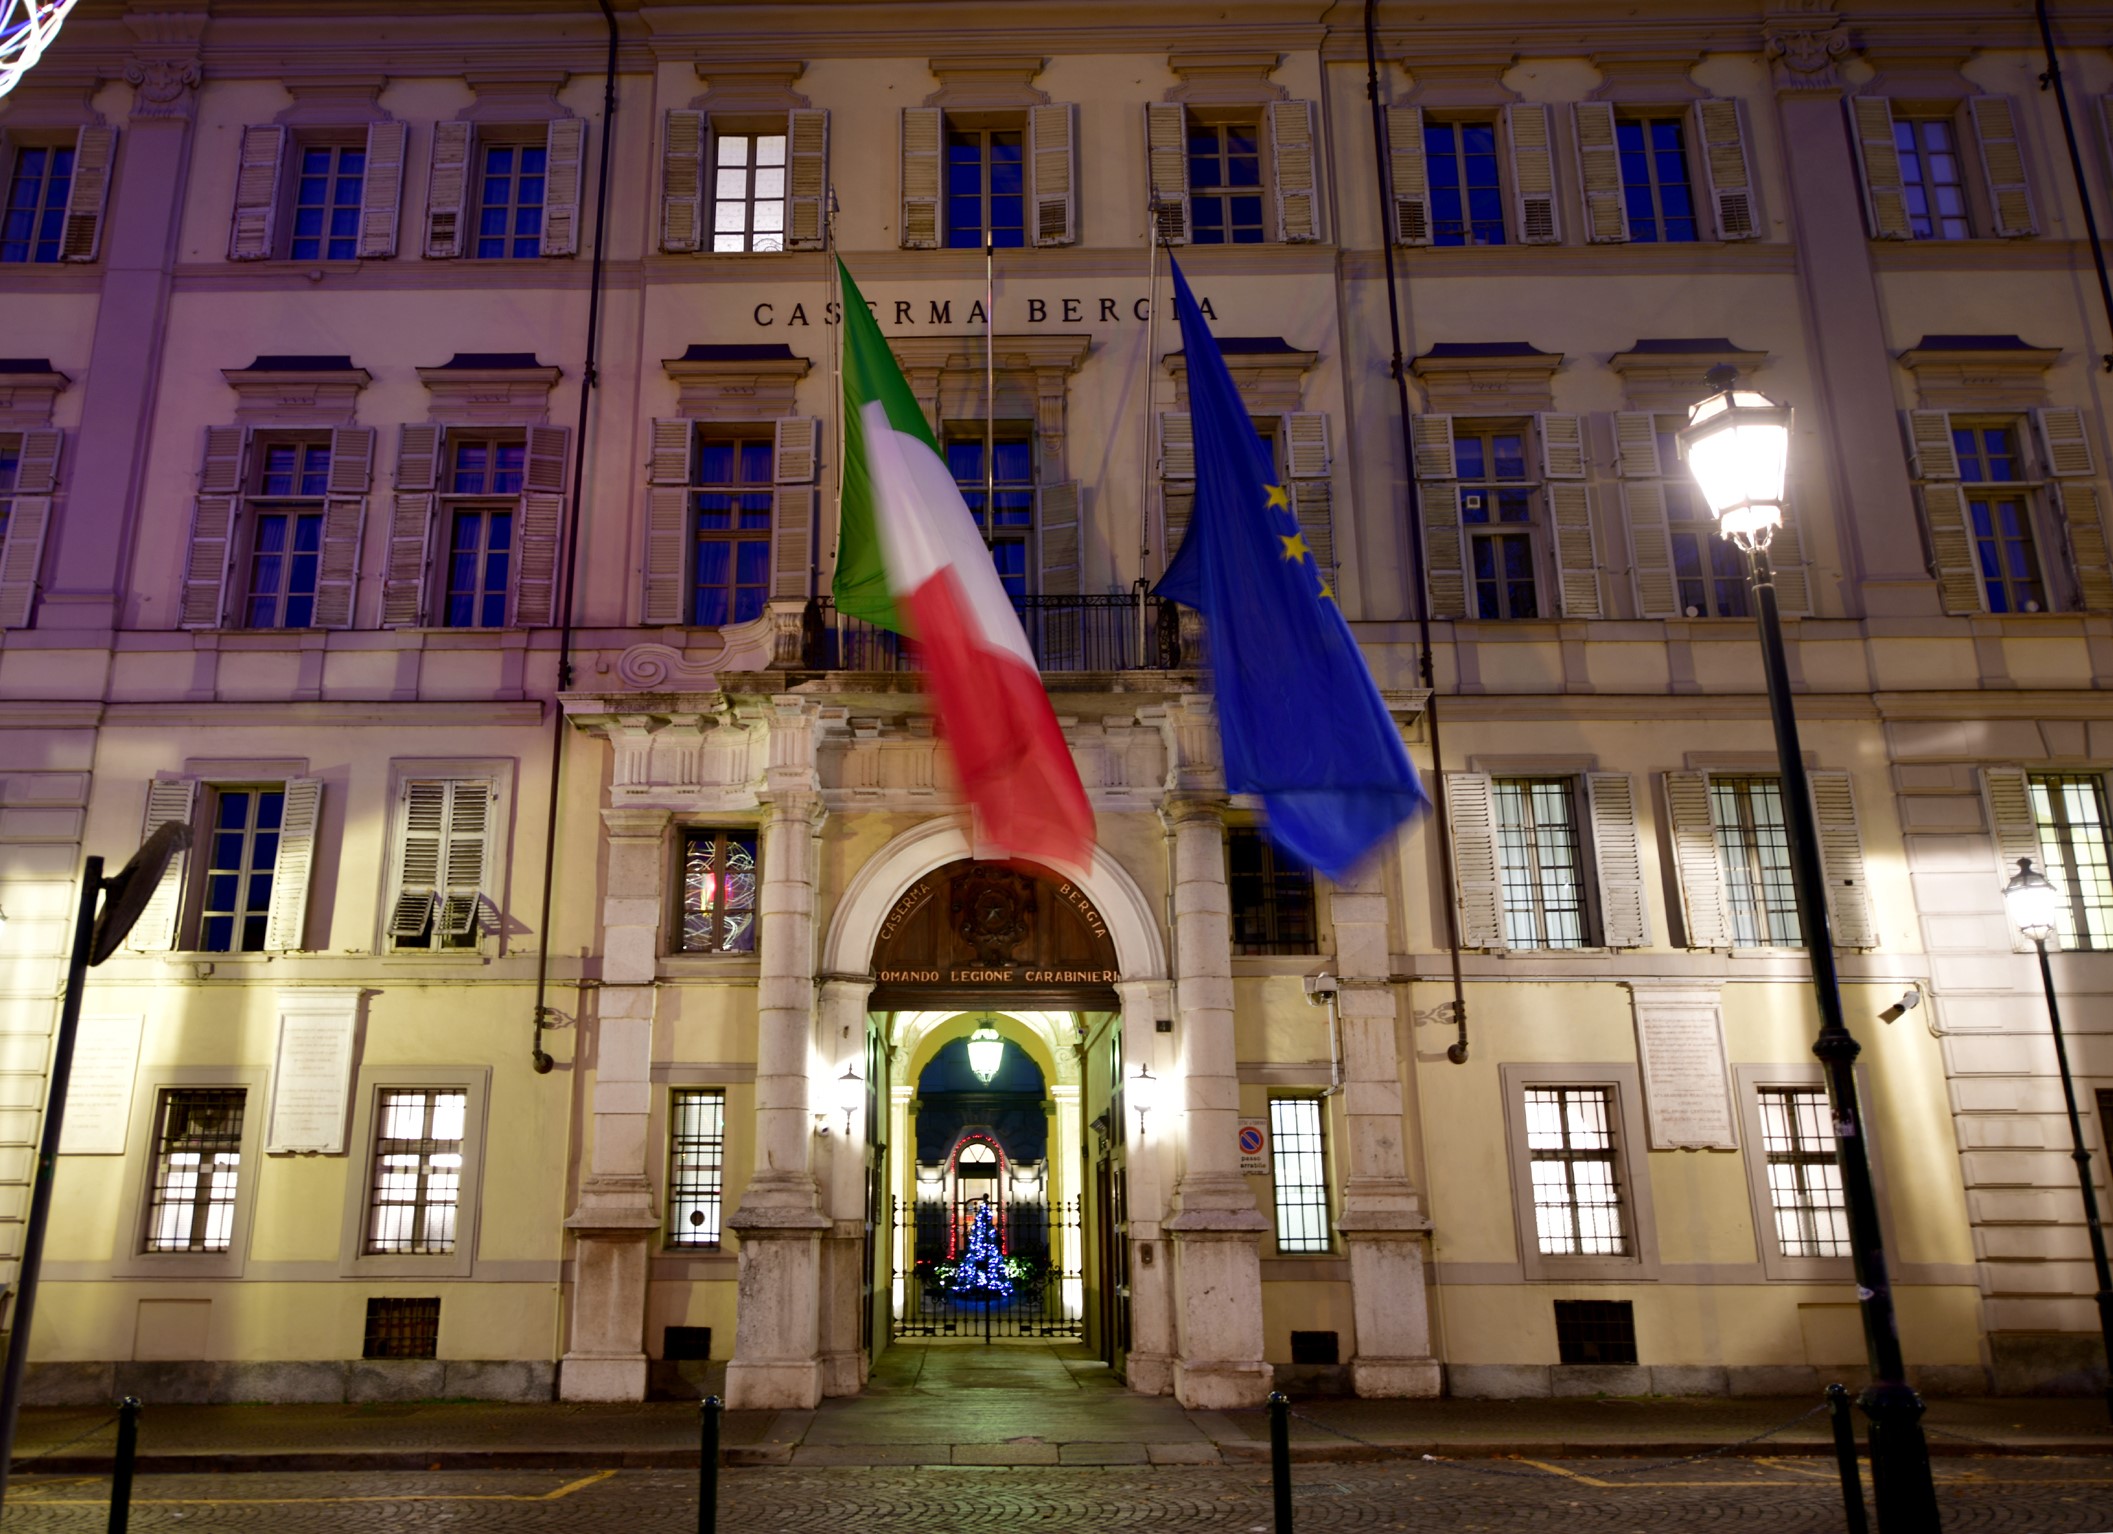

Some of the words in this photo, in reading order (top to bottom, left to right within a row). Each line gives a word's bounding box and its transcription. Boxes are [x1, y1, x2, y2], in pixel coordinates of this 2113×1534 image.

[1028, 297, 1218, 324] BERGIA
[881, 883, 930, 940] CASERMA
[1060, 883, 1106, 938] BERGIA
[951, 970, 1013, 982] LEGIONE
[1025, 970, 1118, 982] CARABINIERI
